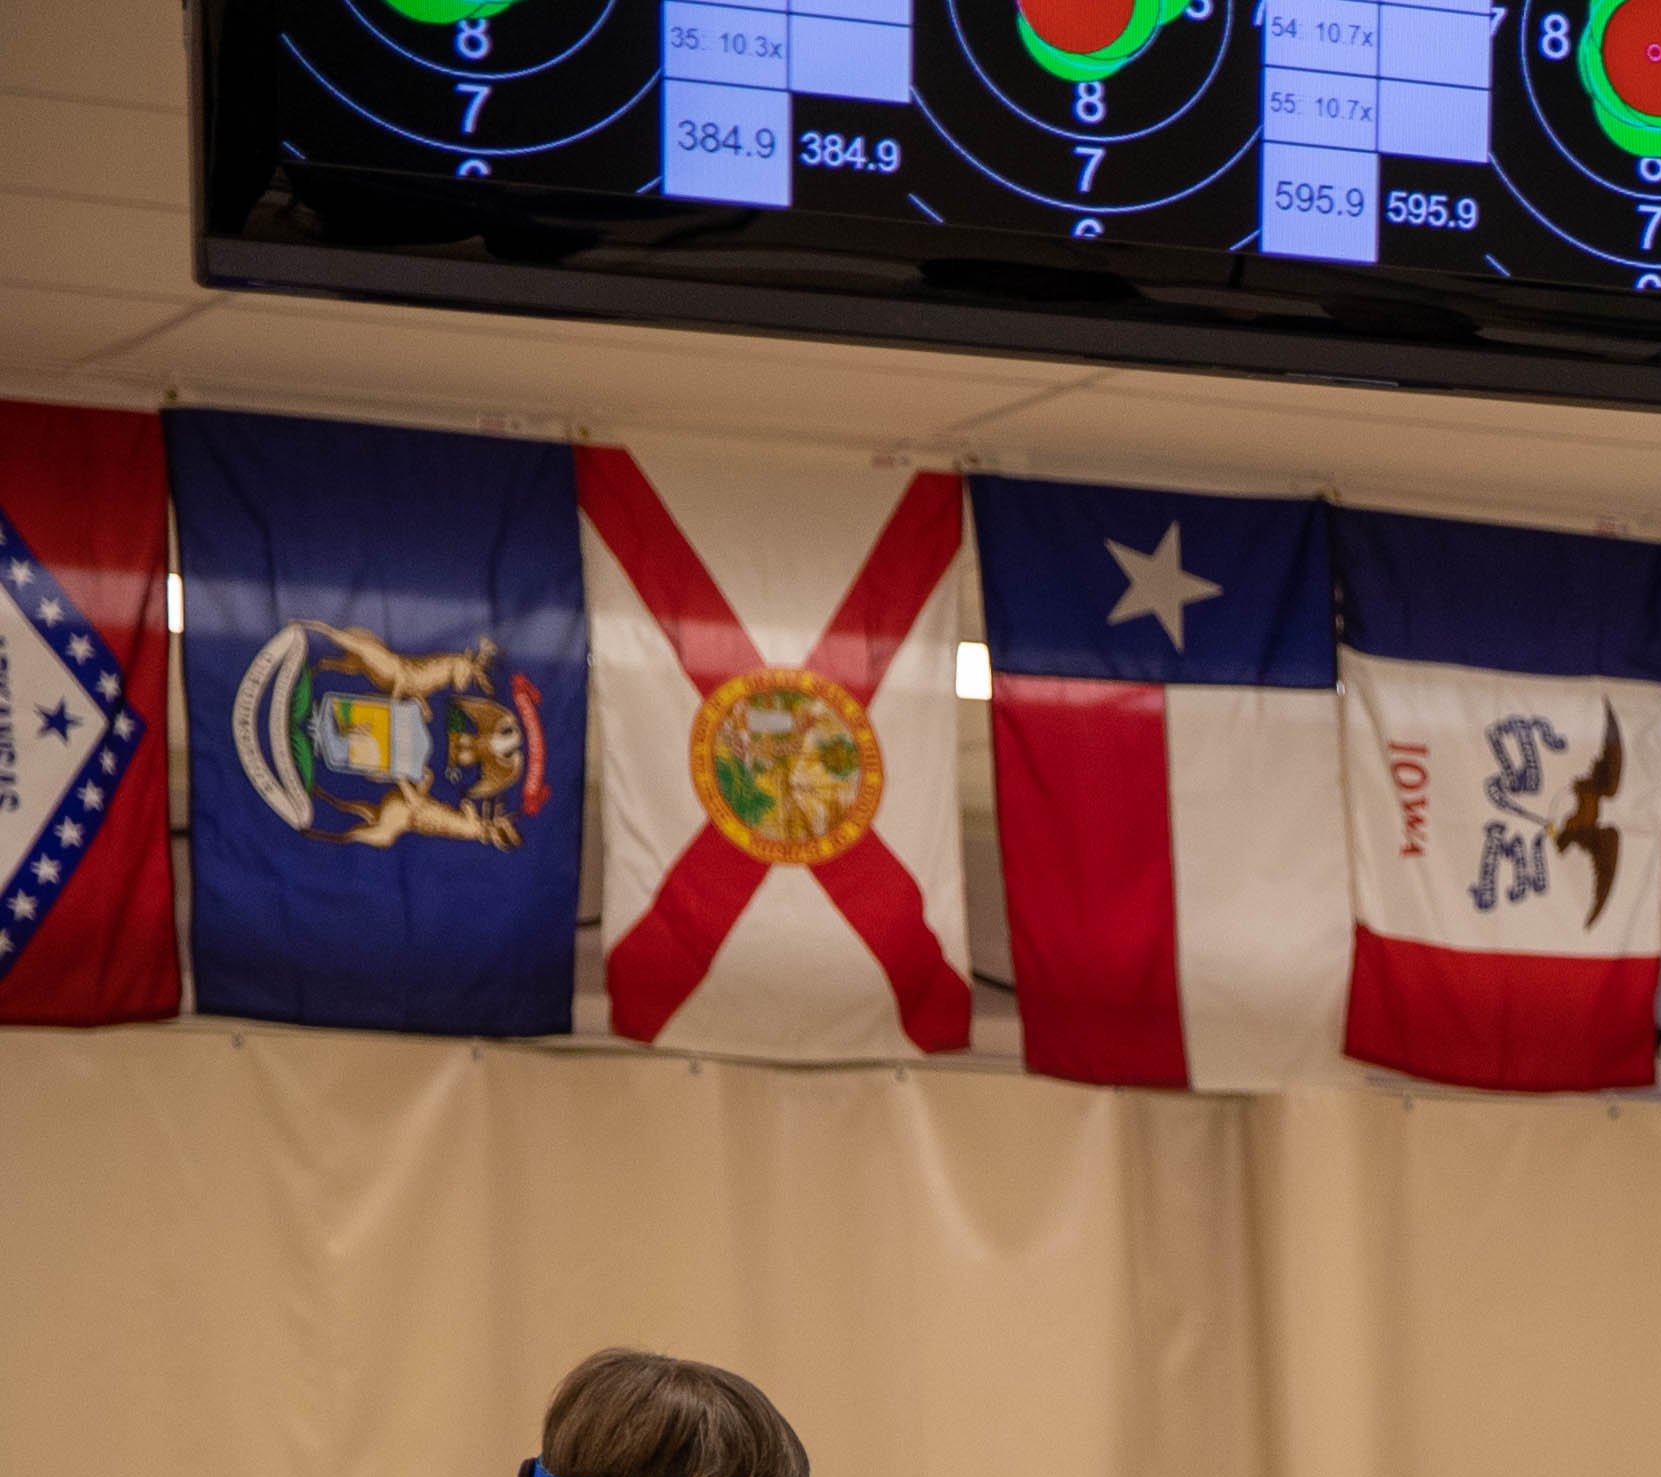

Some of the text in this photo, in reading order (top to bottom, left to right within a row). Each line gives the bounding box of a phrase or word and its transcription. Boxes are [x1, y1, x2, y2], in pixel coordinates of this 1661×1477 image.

[1539, 13, 1570, 61] 8
[455, 84, 492, 134] 7
[677, 120, 900, 172] 384.9 384.9
[1073, 146, 1105, 193] 7
[1275, 180, 1478, 230] 595.9 595.9
[1388, 738, 1431, 860] IOWA
